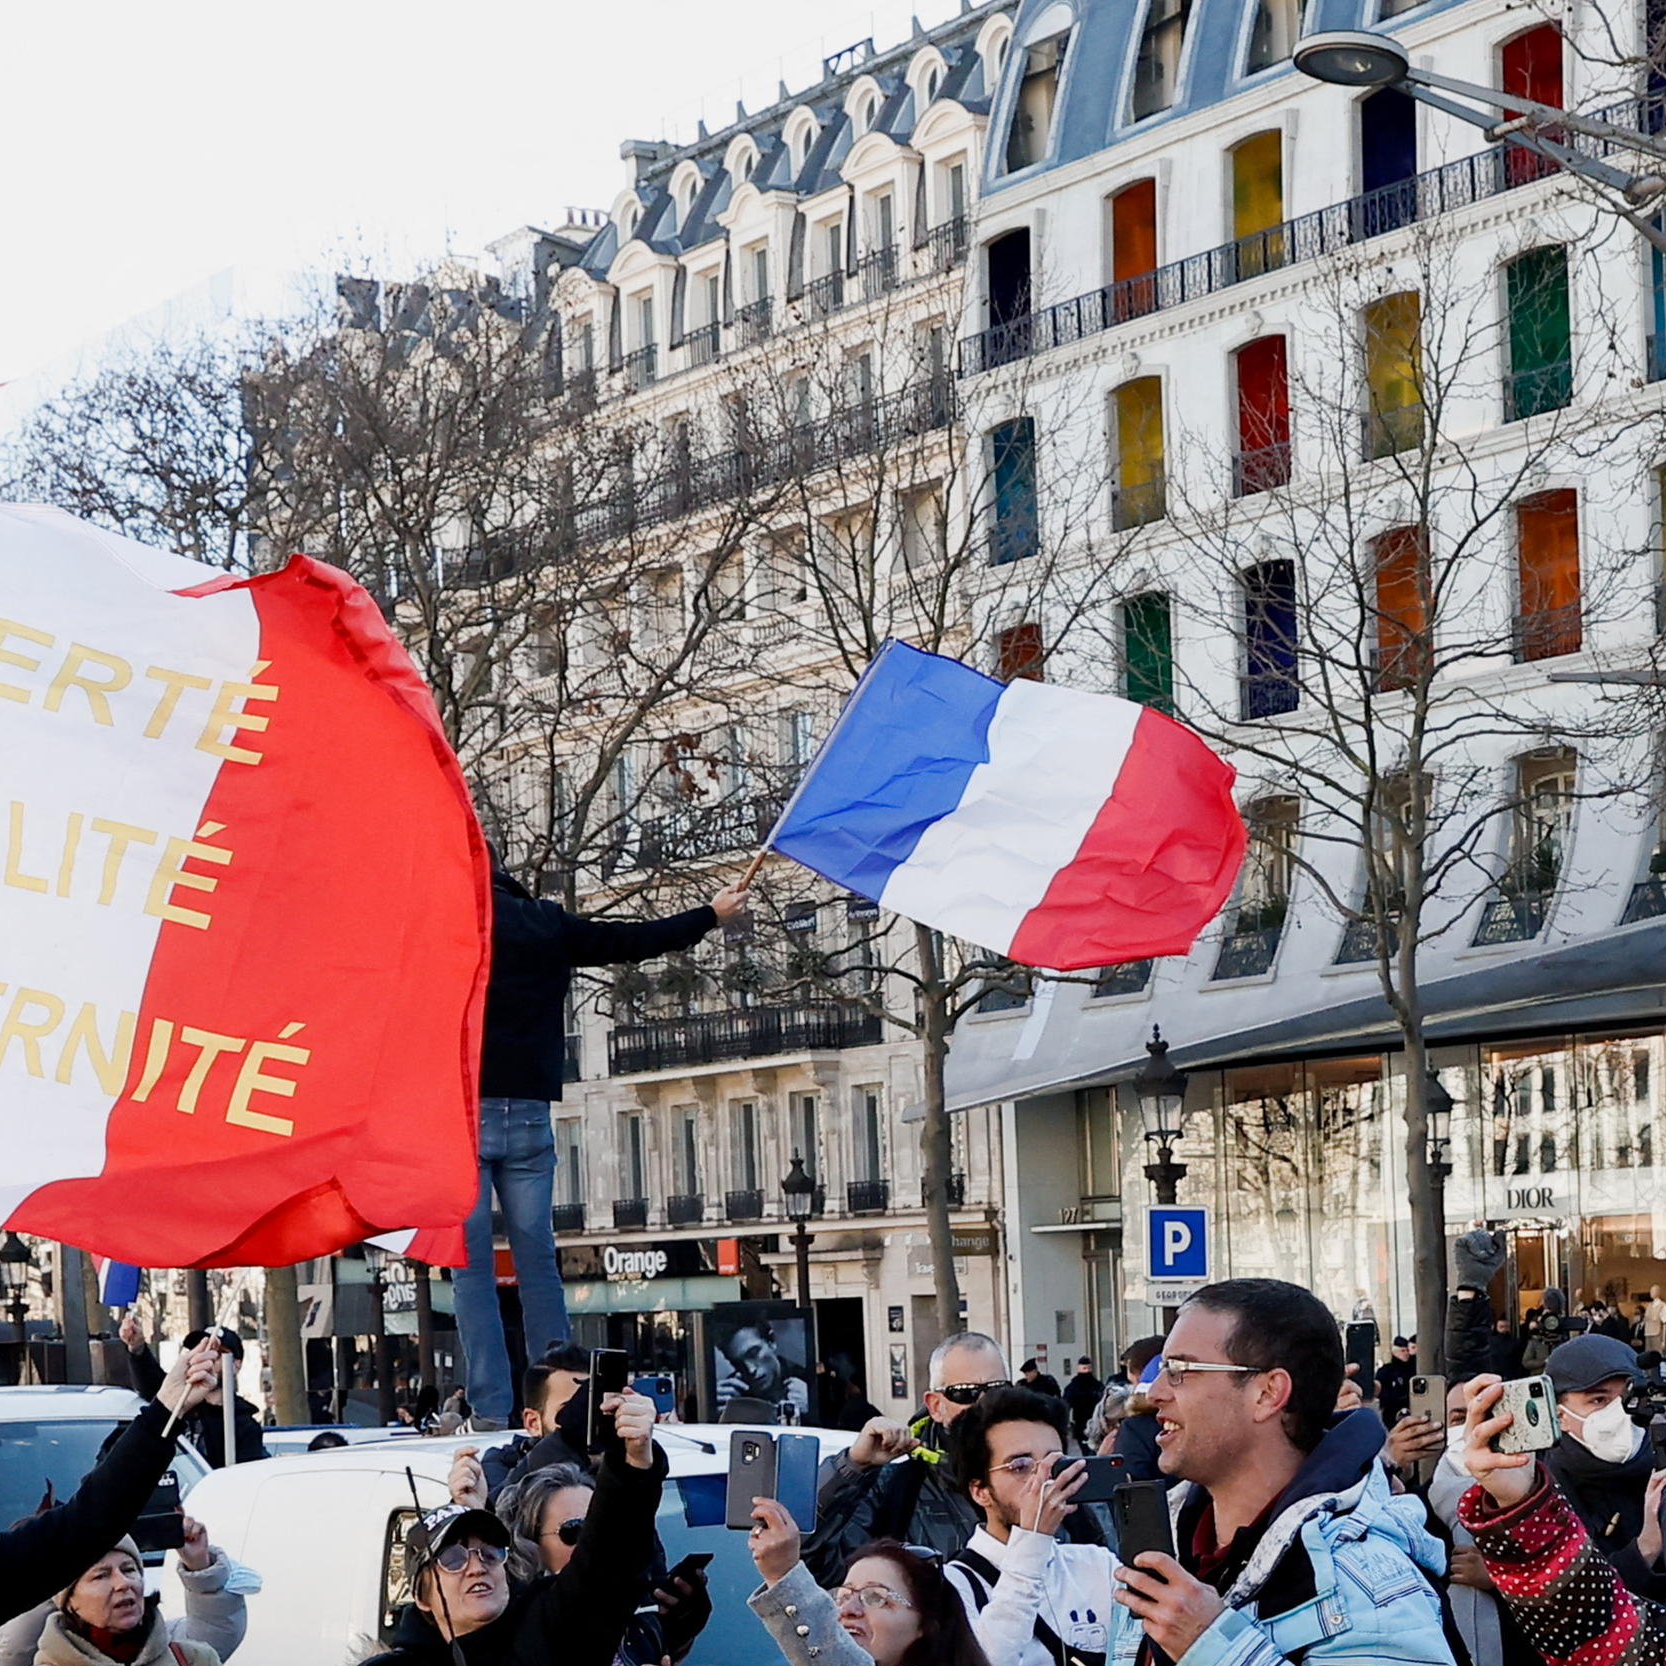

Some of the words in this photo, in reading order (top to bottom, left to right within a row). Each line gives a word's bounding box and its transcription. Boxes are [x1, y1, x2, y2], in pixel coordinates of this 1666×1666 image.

[1507, 1187, 1555, 1209] DIOR
[952, 1235, 990, 1250] hange
[1164, 1221, 1191, 1266] P
[604, 1246, 668, 1279] Orange
